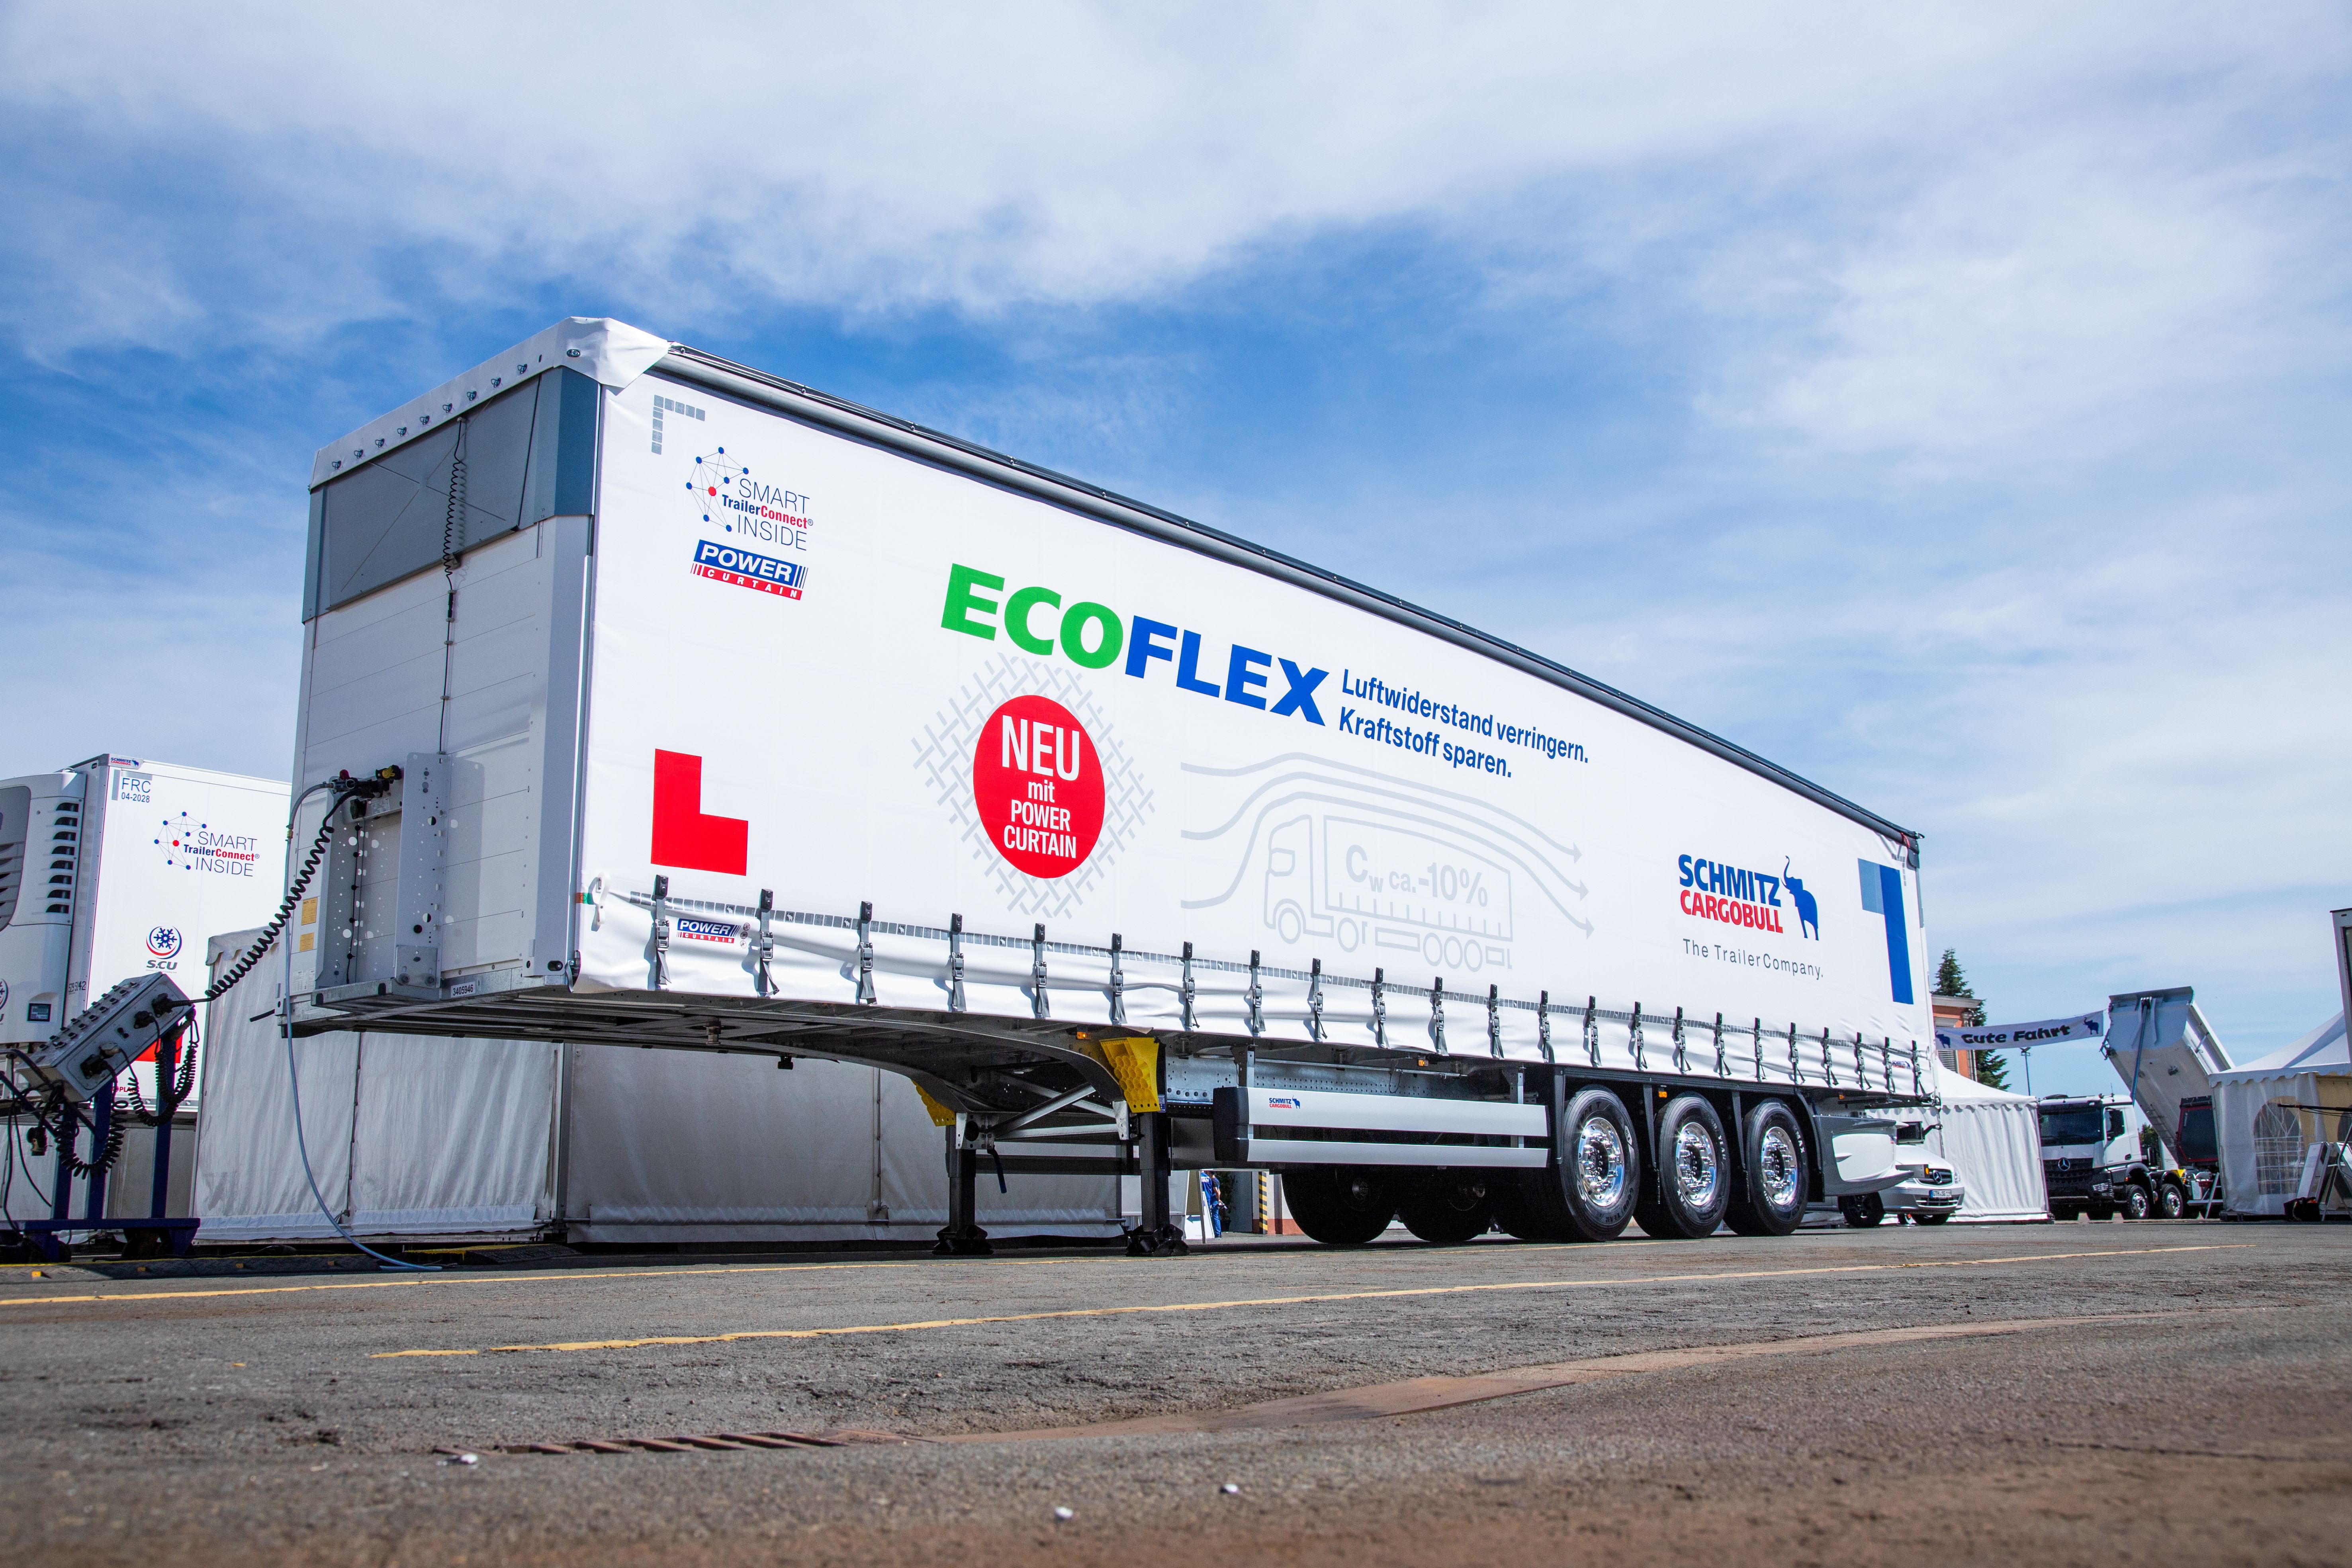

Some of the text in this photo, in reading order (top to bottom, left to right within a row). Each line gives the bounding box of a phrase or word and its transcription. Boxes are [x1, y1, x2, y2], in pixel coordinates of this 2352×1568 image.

[739, 478, 810, 514] SMART
[738, 514, 806, 551] INSIDE
[700, 544, 792, 582] POWER
[707, 569, 797, 598] CURTAIN
[941, 563, 1330, 726] ECOFLEX
[1342, 669, 1589, 763] Luftwiderstand verringern.
[1001, 715, 1080, 781] NEU
[1339, 707, 1512, 777] Kraftstoff sparen.
[121, 792, 150, 803] 04-2028
[122, 777, 151, 793] FRC
[1027, 779, 1055, 803] mit
[1010, 800, 1071, 832] POWER
[198, 831, 257, 851] SMART
[1004, 824, 1076, 859] CURTAIN
[196, 857, 254, 877] INSIDE
[1678, 854, 1781, 907] SCHMITZ
[1680, 890, 1783, 934] CARGOBULL
[680, 920, 731, 935] POWER
[685, 933, 732, 943] CURTAIN
[1683, 938, 1708, 958] The
[453, 984, 474, 996] 3405946
[1961, 1025, 2070, 1043] Gute Fahrt
